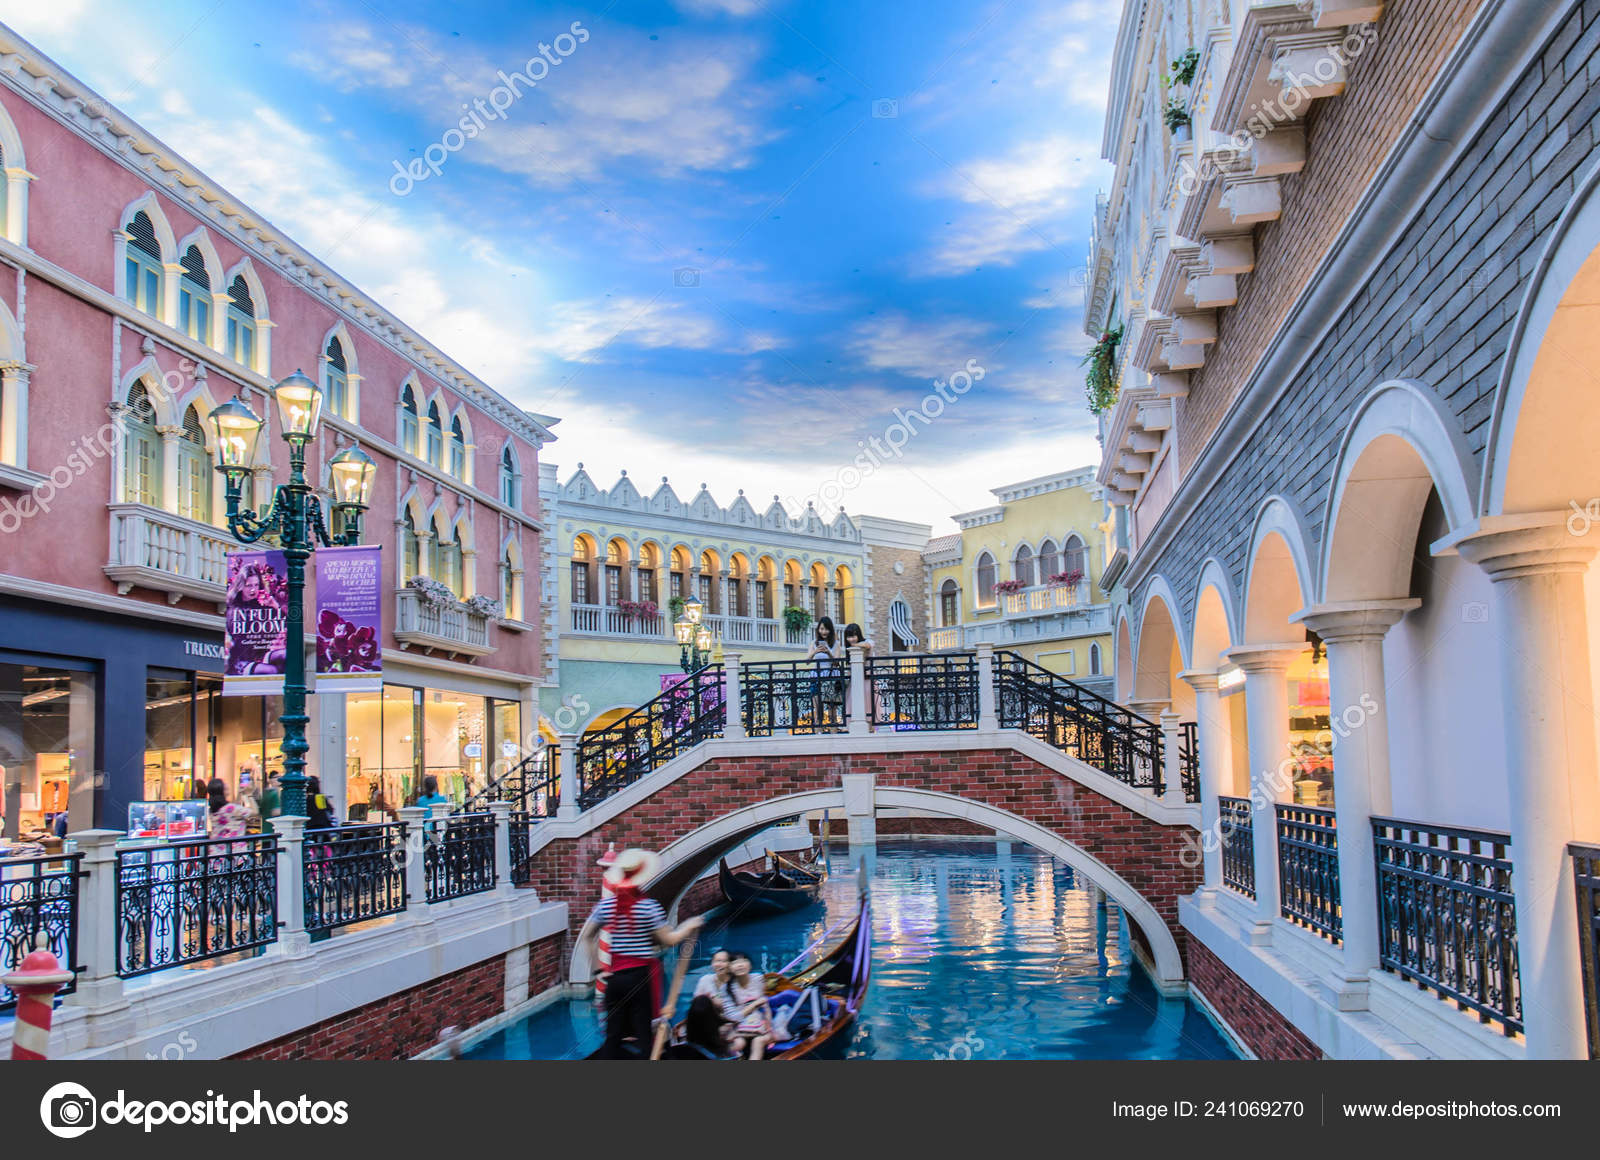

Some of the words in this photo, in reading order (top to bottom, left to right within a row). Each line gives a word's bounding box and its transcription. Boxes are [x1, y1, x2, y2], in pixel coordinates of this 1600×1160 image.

[232, 607, 248, 622] IN
[249, 607, 286, 621] FULL
[232, 620, 286, 635] BLOOM
